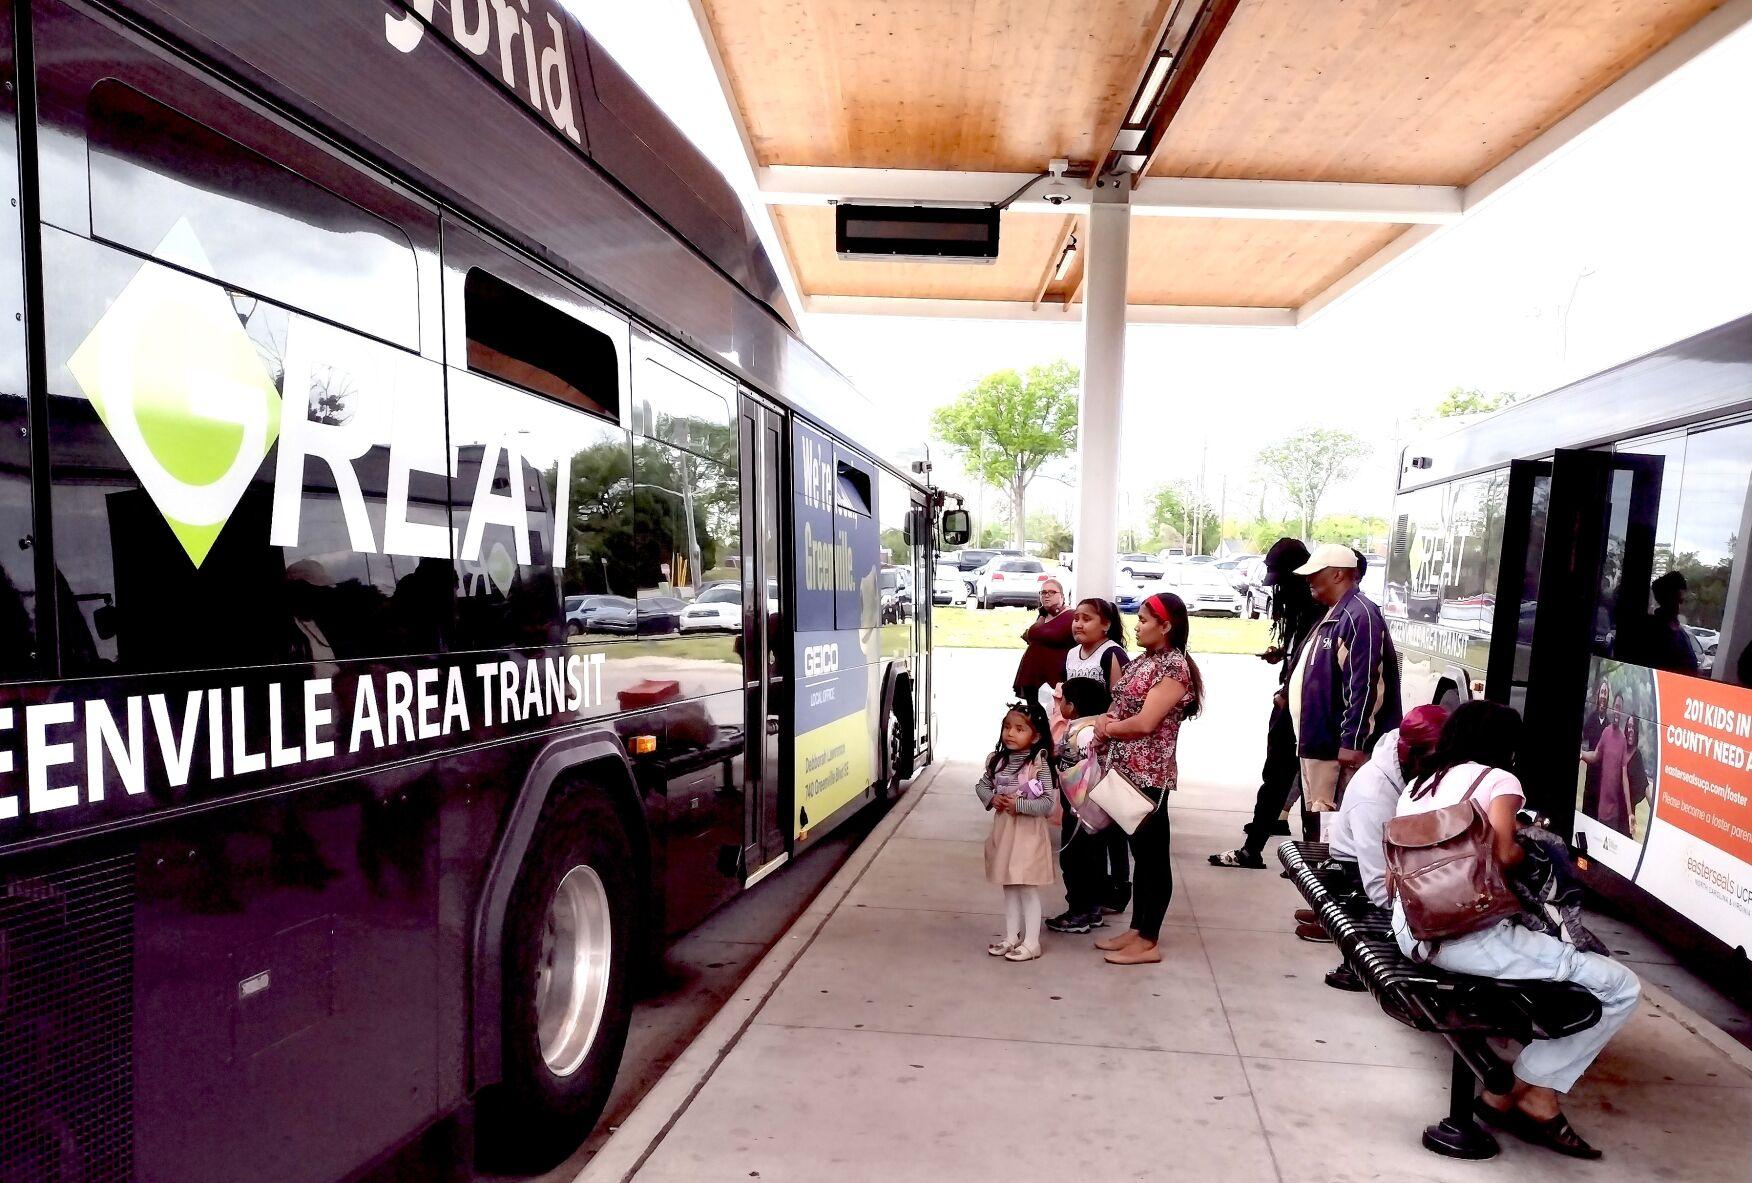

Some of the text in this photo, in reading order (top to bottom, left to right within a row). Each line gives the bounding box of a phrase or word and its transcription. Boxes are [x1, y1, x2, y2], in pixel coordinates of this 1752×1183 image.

[804, 643, 839, 677] GEICO
[349, 666, 470, 753] AREA
[476, 652, 606, 727] TRANSIT
[1683, 697, 1752, 739] 201 KIDS IN
[1666, 724, 1713, 759] COUNTY
[1712, 739, 1745, 769] NEED
[1664, 764, 1748, 807] eastersealsucp.com/foster
[1661, 791, 1681, 809] Please
[1680, 799, 1706, 821] become
[1705, 813, 1712, 824] a
[1711, 813, 1731, 832] foster
[1687, 857, 1735, 894] easterseals
